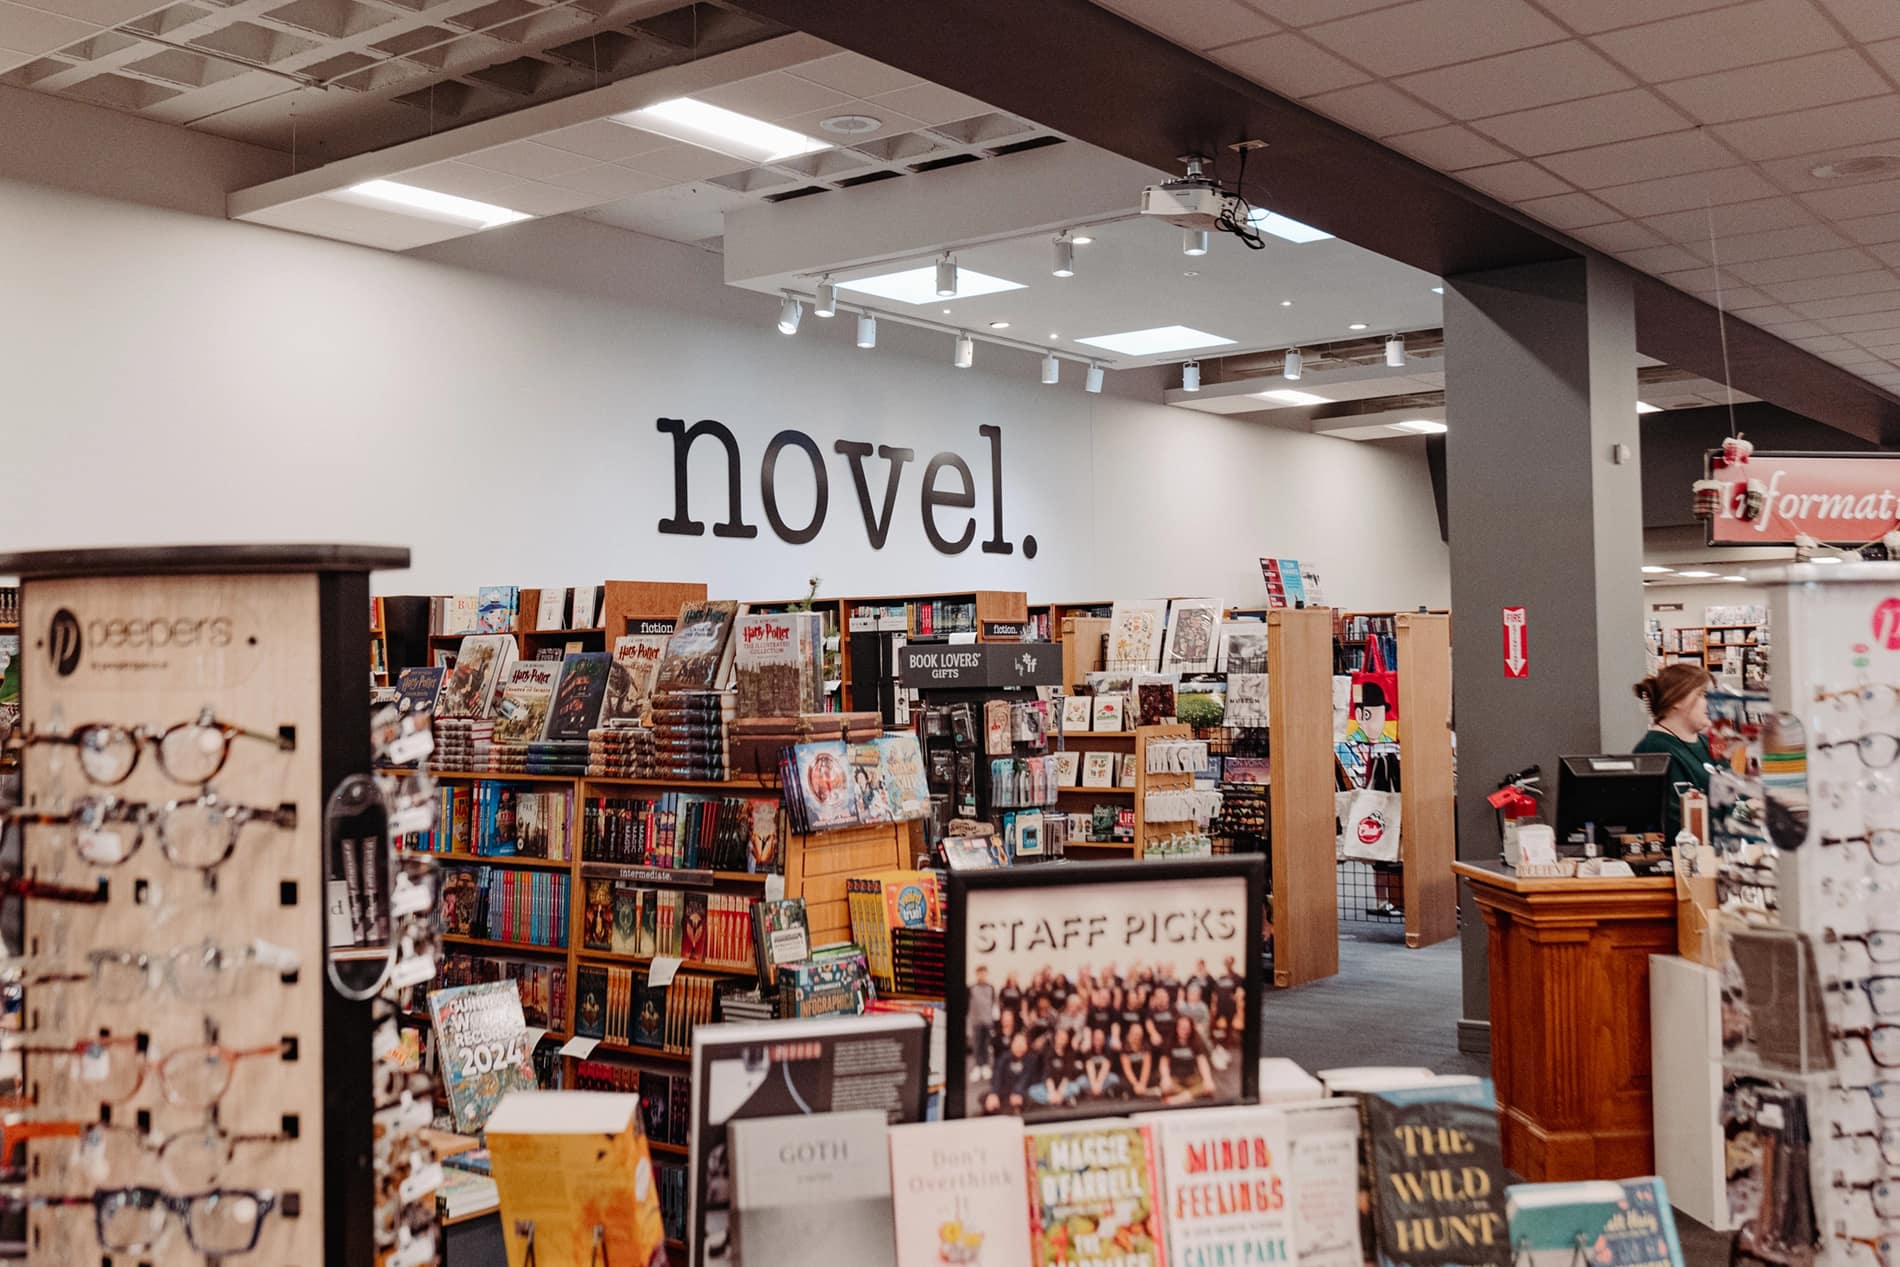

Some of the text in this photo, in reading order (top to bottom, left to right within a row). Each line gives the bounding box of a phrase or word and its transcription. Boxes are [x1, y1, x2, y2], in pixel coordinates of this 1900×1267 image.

[656, 418, 1038, 560] novel.
[640, 622, 673, 634] fiction
[743, 624, 790, 643] Harry Potter
[993, 624, 1018, 634] fiction.
[619, 643, 660, 660] Harry Potter
[909, 654, 938, 668] BOOK
[932, 668, 959, 678] GIFTS
[620, 869, 672, 881] intermediate.
[976, 908, 1237, 953] STAFF PICKS
[459, 1038, 524, 1078] 2024
[778, 1141, 848, 1164] GOTH
[1185, 1136, 1271, 1174] MINOR
[1394, 1124, 1475, 1158] THE
[1176, 1175, 1284, 1220] FEELINGS
[1391, 1167, 1491, 1204] WILD
[1394, 1212, 1499, 1254] HUNT
